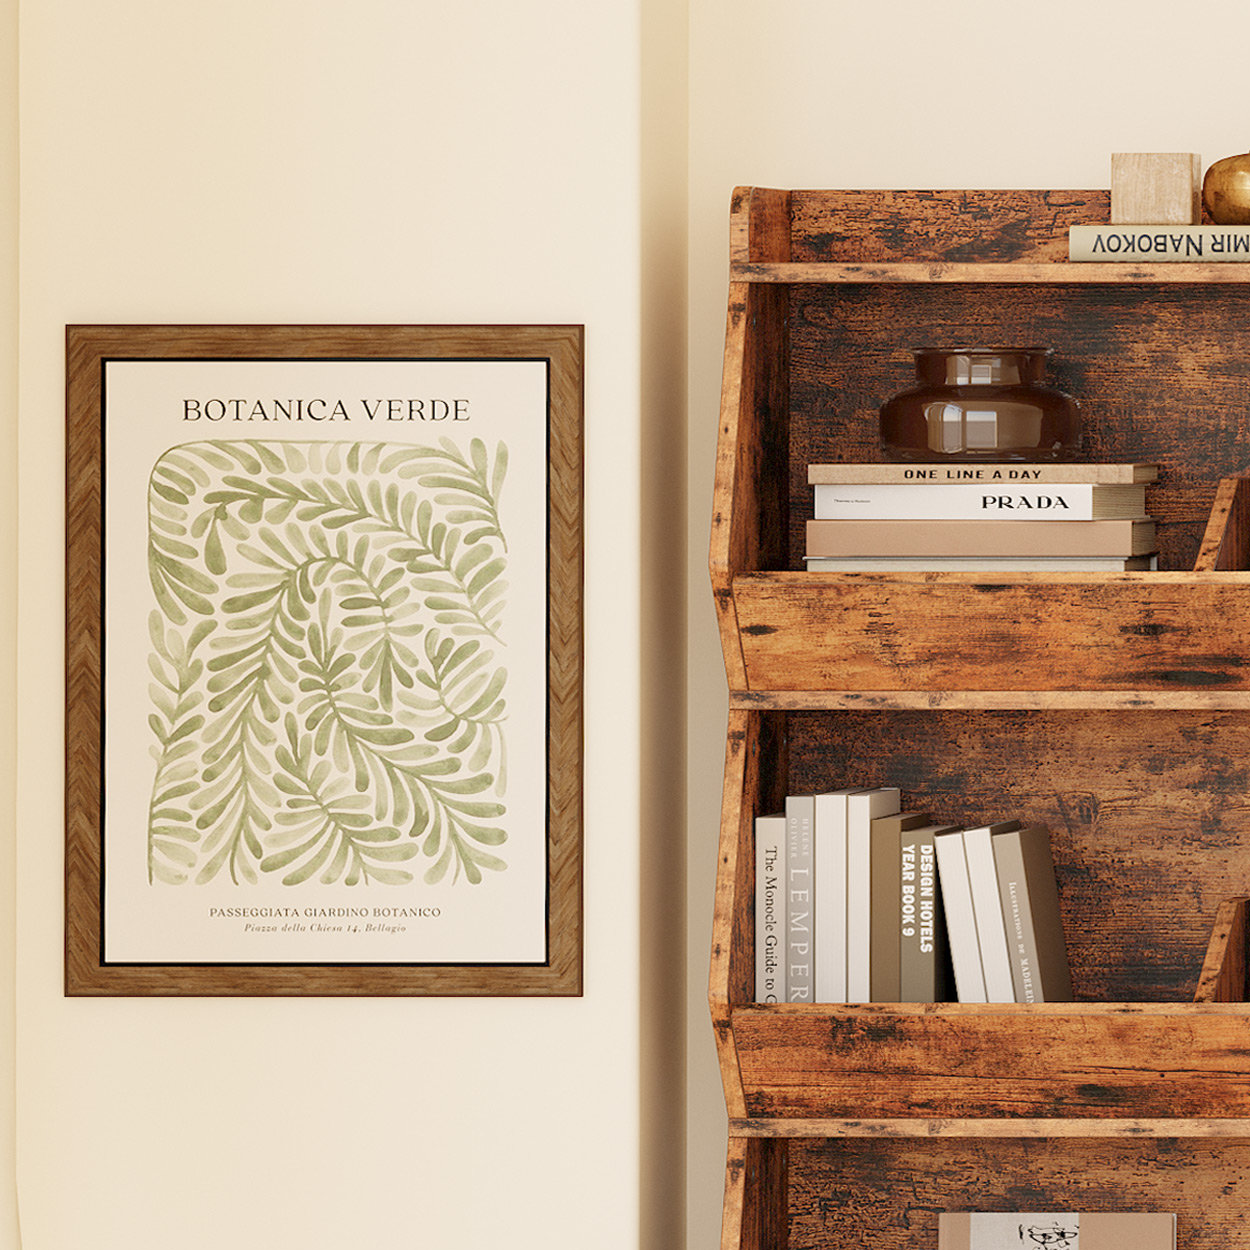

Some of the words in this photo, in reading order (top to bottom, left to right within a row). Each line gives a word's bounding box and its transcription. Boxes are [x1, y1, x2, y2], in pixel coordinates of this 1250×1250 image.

[1092, 234, 1203, 257] NABOKOV
[182, 398, 351, 422] BOTANICA
[360, 399, 471, 422] VERDE
[904, 469, 938, 480] ONE
[946, 469, 985, 480] LINE
[992, 469, 1003, 480] A
[1008, 469, 1042, 480] DAY
[981, 495, 1070, 510] PRADA
[765, 845, 778, 872] The
[902, 844, 916, 881] YEAR
[920, 844, 933, 896] DESIGN
[209, 907, 300, 918] PASSEGGIATA
[304, 907, 369, 918] GIARDINO
[372, 907, 441, 918] BOTANICO
[765, 876, 778, 932] Monocle
[902, 885, 916, 924] BOOK
[790, 868, 809, 1002] LEMPER
[902, 928, 916, 937] 9
[920, 900, 933, 953] HOTELS
[765, 934, 778, 974] Guide
[765, 977, 776, 991] to
